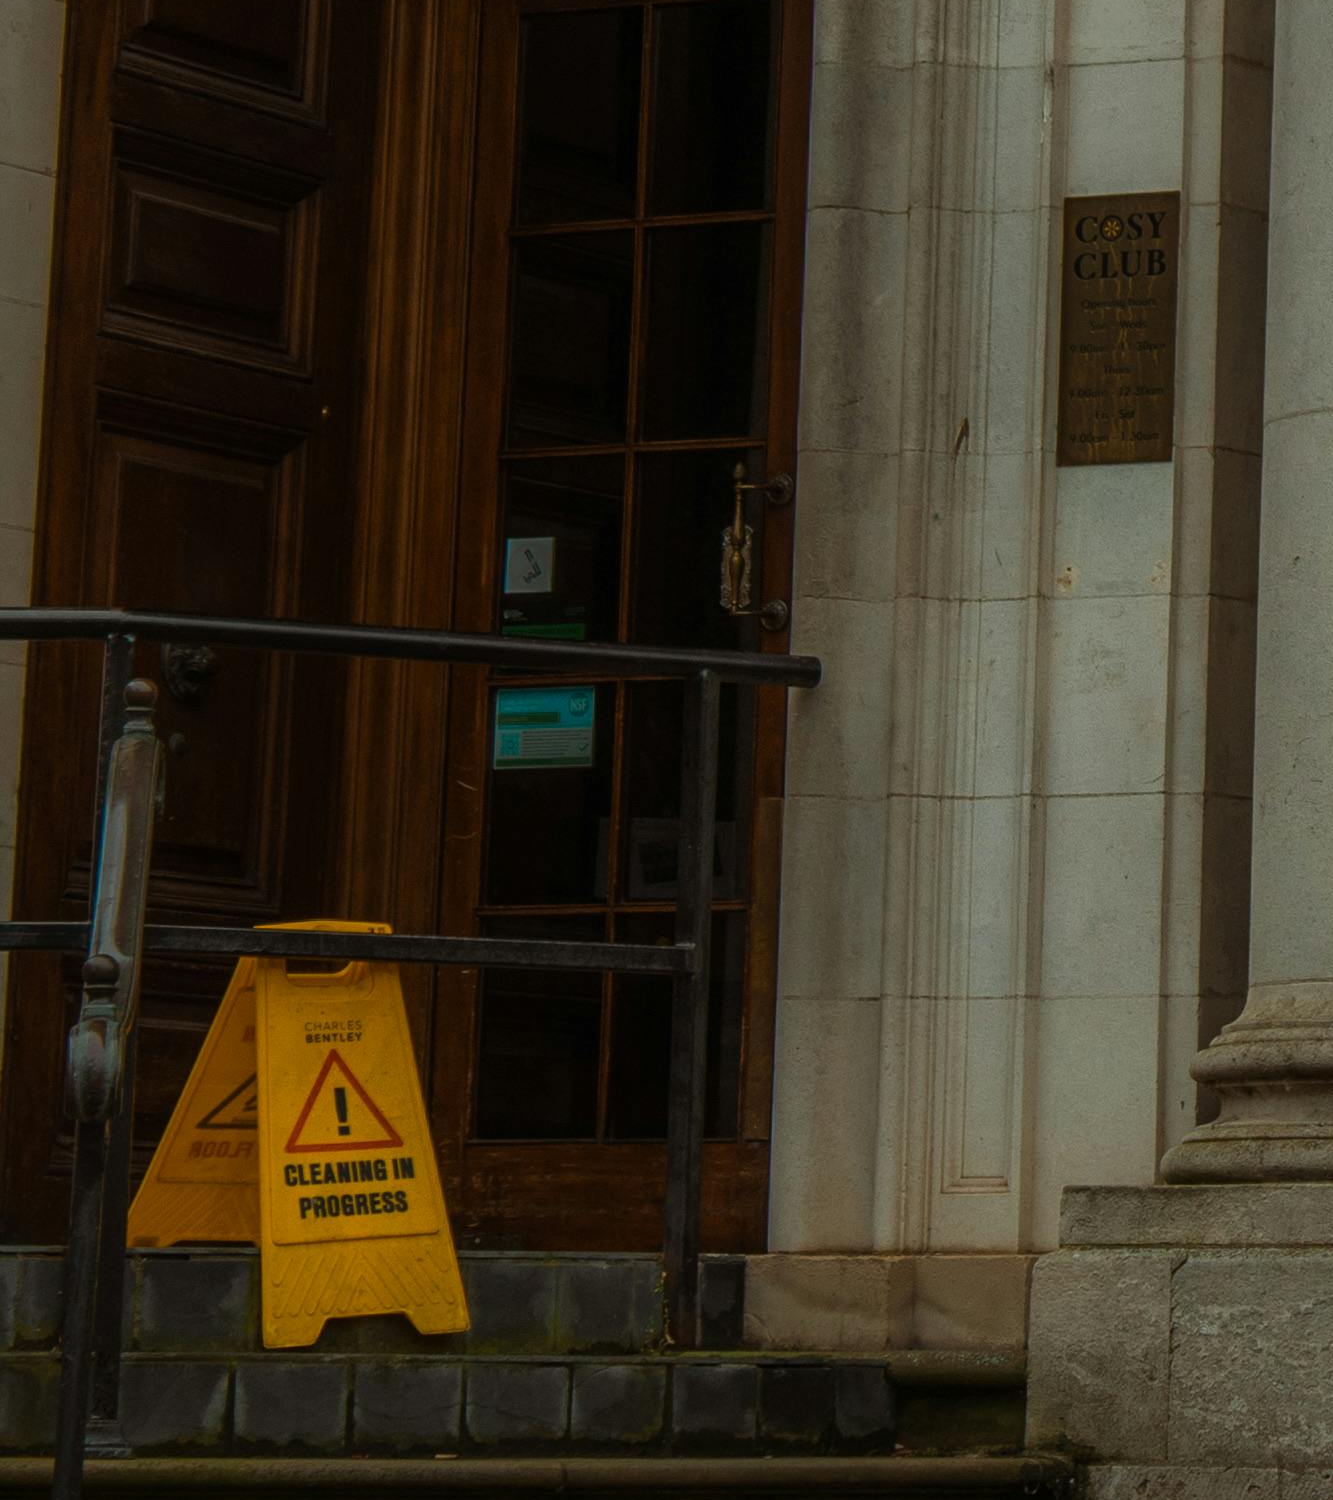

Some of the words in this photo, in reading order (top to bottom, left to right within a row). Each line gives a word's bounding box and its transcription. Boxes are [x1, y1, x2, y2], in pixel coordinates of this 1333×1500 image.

[1075, 211, 1168, 244] COSY
[1073, 249, 1167, 281] CLUB
[570, 698, 587, 712] NSF
[304, 1019, 363, 1033] CHARLES
[305, 1031, 364, 1044] BENTLEY
[284, 1159, 388, 1187] CLEANING
[393, 1156, 415, 1181] IN
[299, 1191, 409, 1219] PROGRESS
